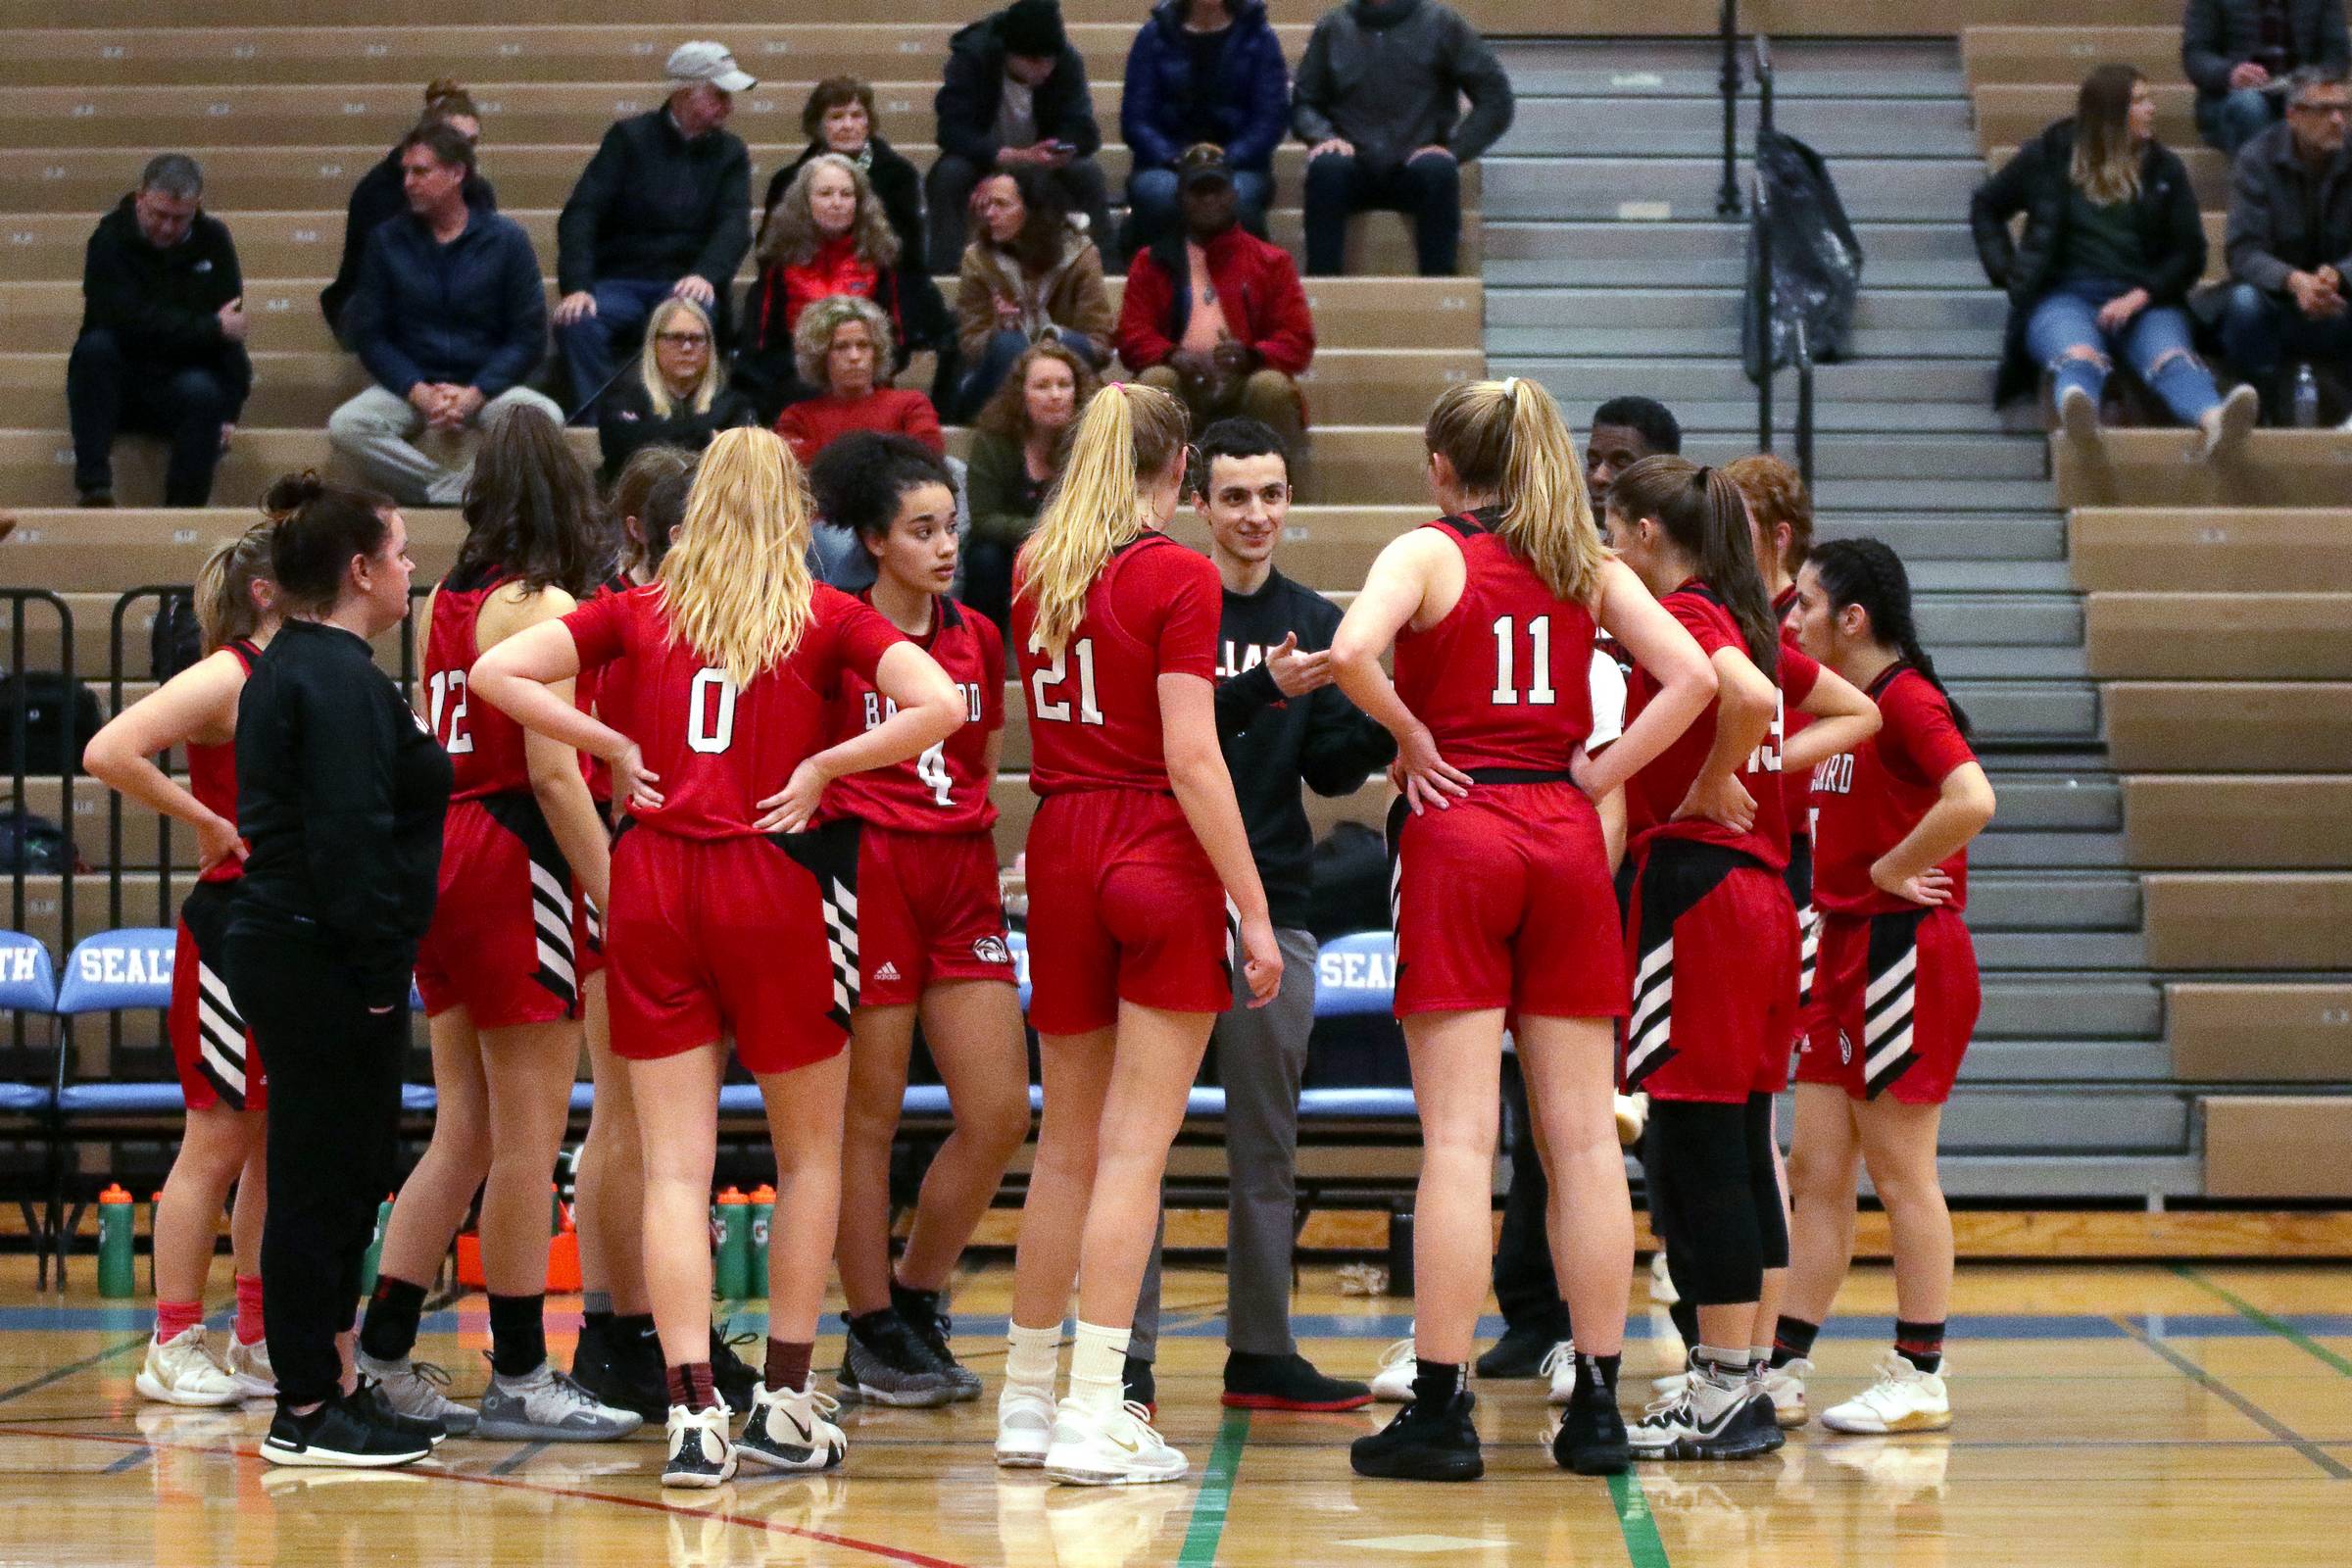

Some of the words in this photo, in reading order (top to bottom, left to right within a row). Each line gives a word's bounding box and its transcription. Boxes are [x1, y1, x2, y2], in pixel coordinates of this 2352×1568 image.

[1028, 632, 1103, 725] 21
[1492, 615, 1555, 705] 11
[430, 669, 474, 754] 12
[688, 667, 737, 755] 0
[916, 738, 957, 807] 4
